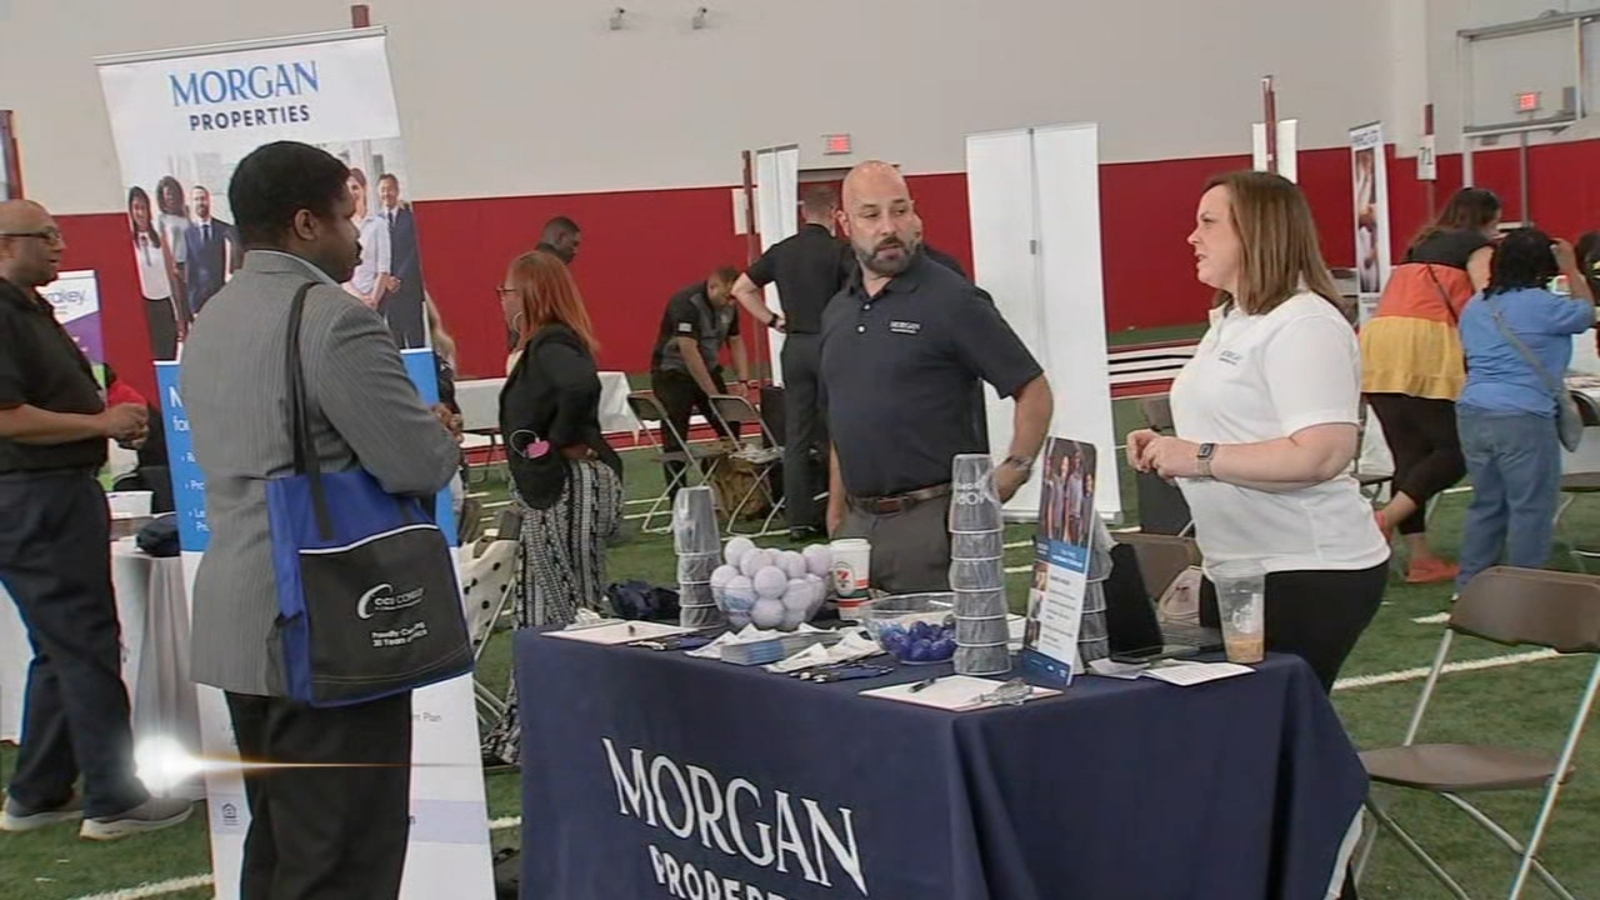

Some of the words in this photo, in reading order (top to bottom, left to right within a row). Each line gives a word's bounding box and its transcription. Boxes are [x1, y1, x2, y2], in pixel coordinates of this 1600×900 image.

[169, 60, 320, 107] MORGAN
[189, 104, 311, 131] PROPERTIES
[602, 737, 868, 896] MORGAN
[649, 844, 788, 900] PROPE
